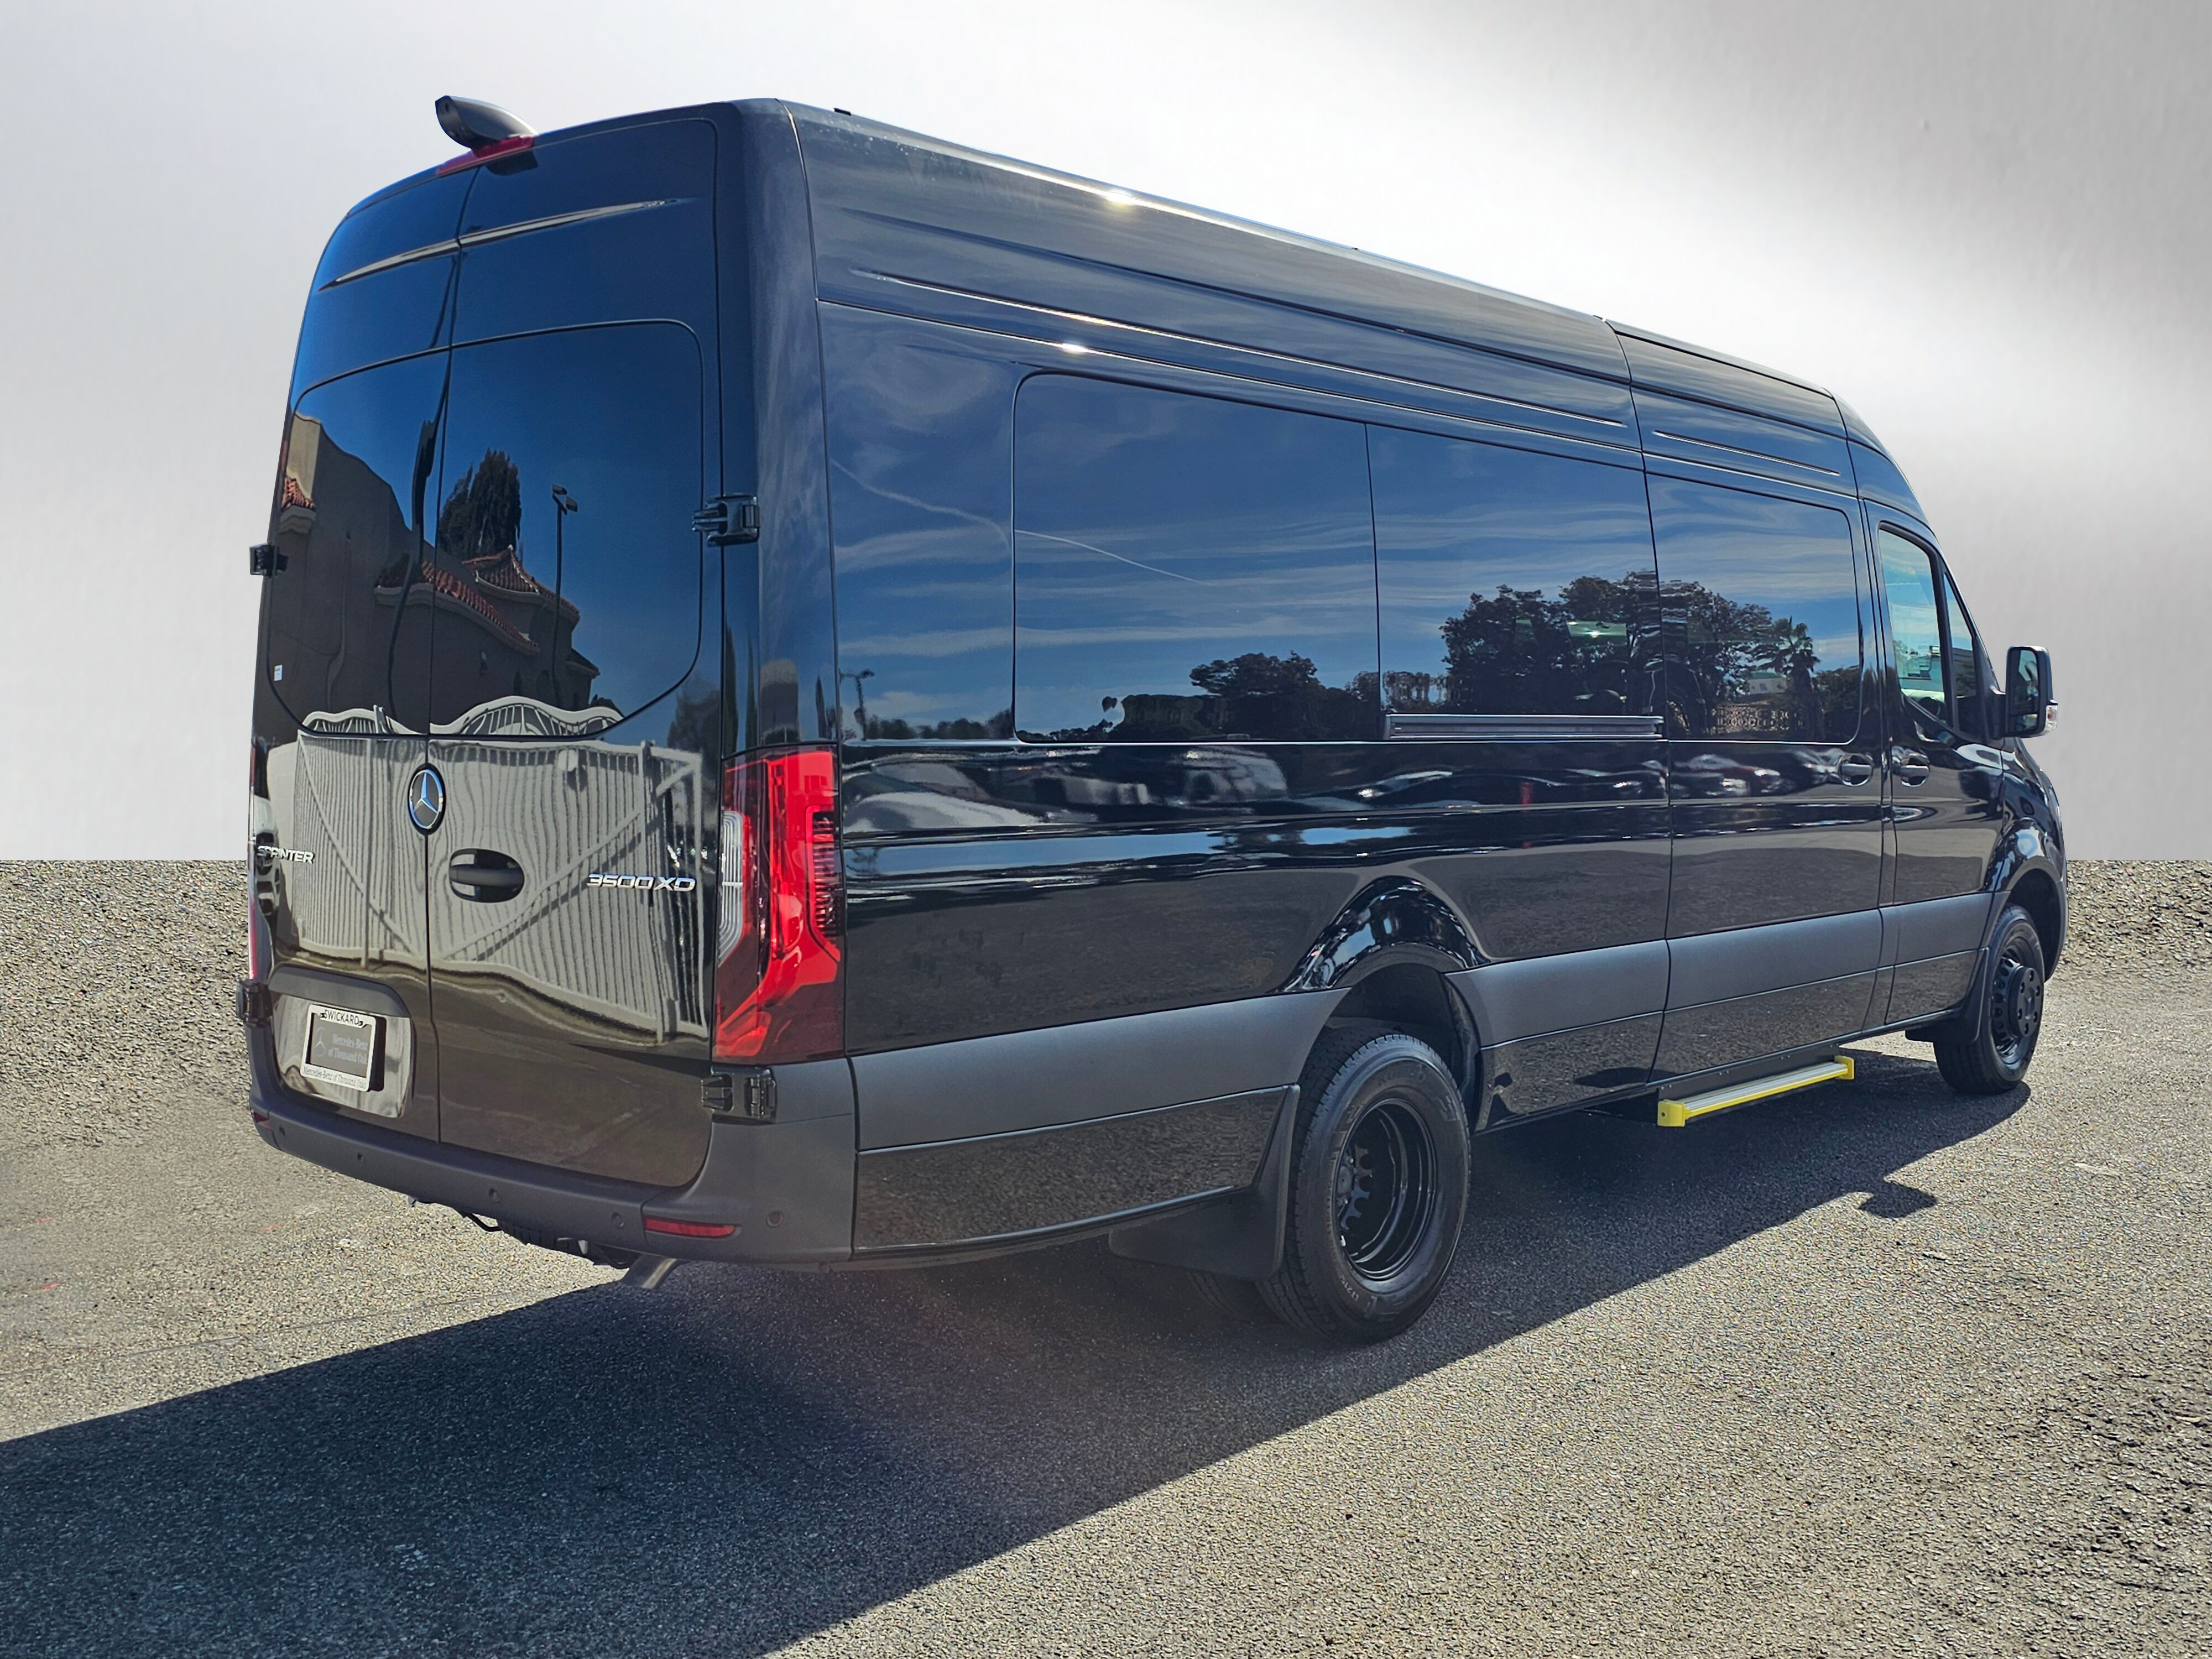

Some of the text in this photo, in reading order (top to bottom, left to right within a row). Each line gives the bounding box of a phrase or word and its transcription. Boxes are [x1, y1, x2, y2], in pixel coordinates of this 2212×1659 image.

[257, 846, 315, 864] SPRINTER
[587, 873, 696, 891] 3500 XD
[324, 1009, 360, 1025] SWICKARD
